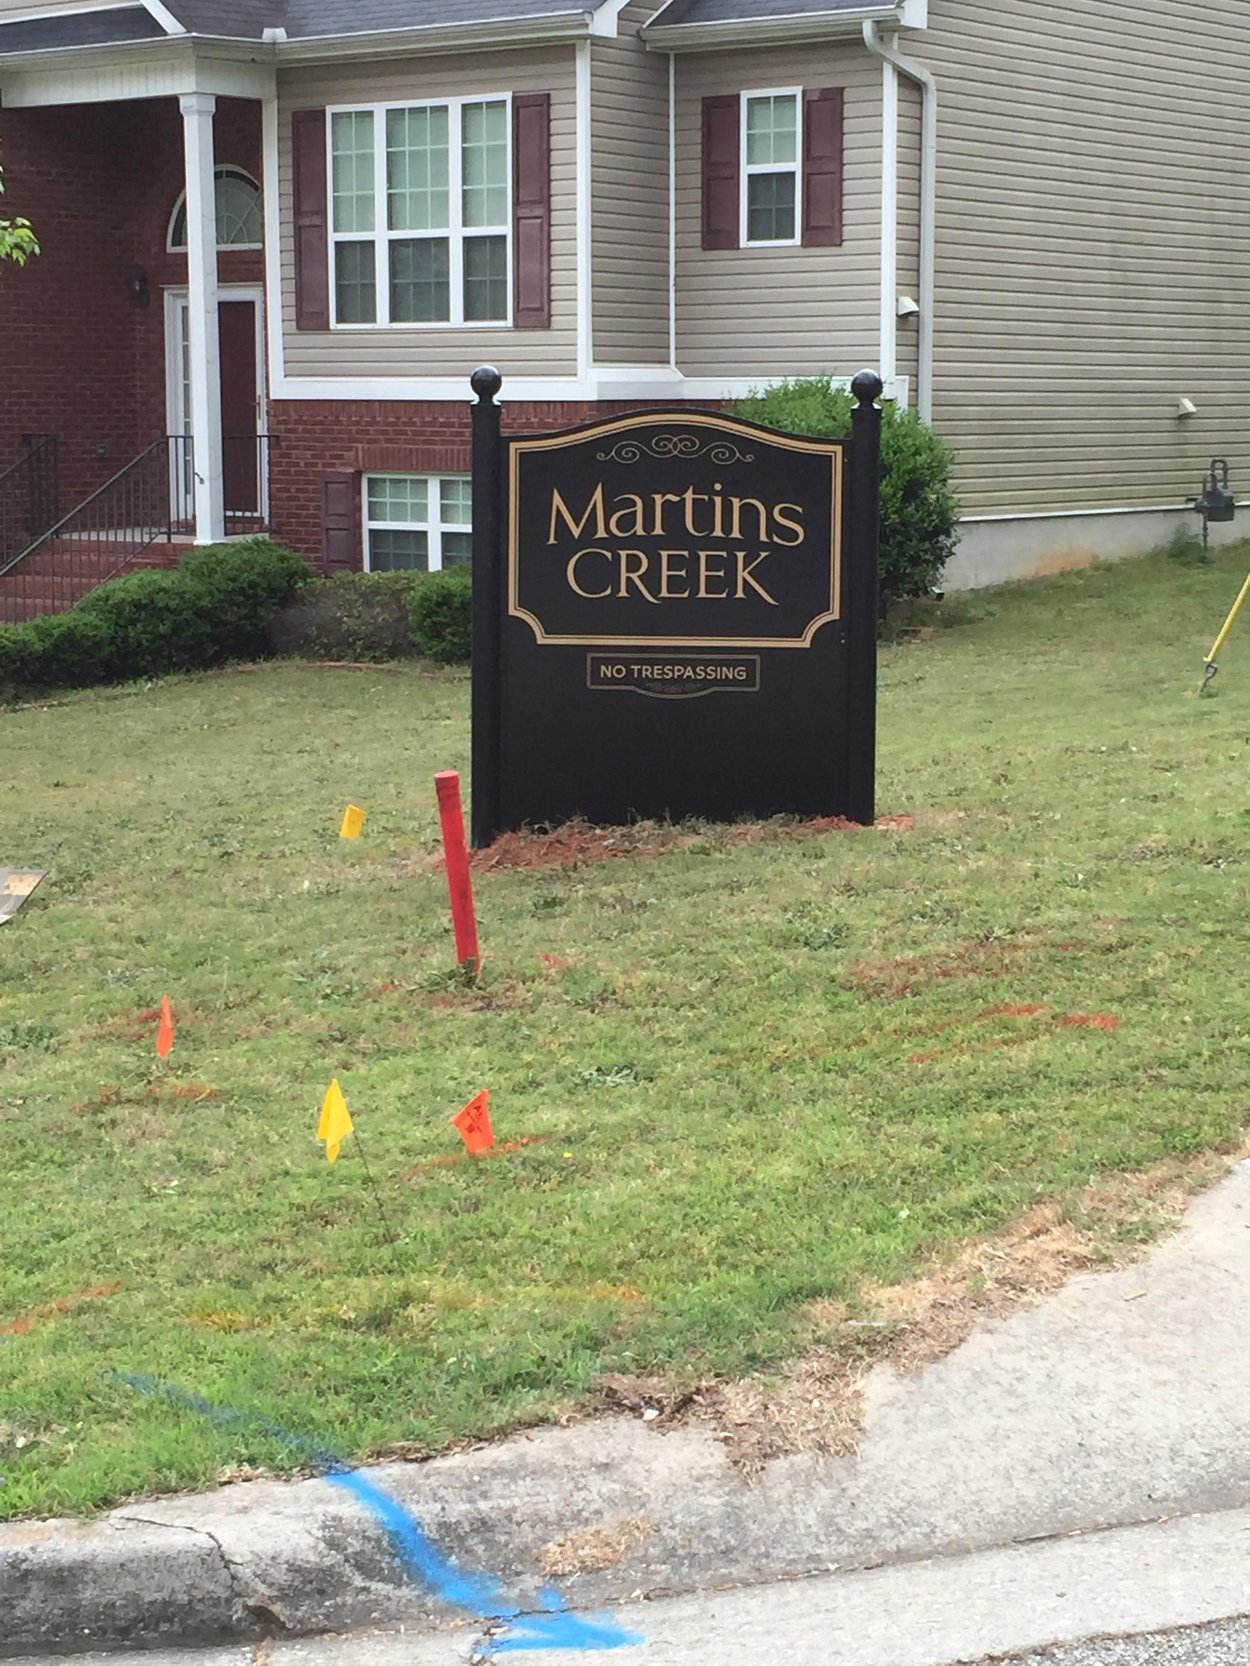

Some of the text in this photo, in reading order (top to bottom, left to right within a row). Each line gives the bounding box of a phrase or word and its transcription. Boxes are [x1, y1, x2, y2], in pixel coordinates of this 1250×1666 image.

[546, 482, 805, 547] Martins
[566, 548, 779, 606] CREEK
[600, 665, 747, 680] NO TRESPASSING
